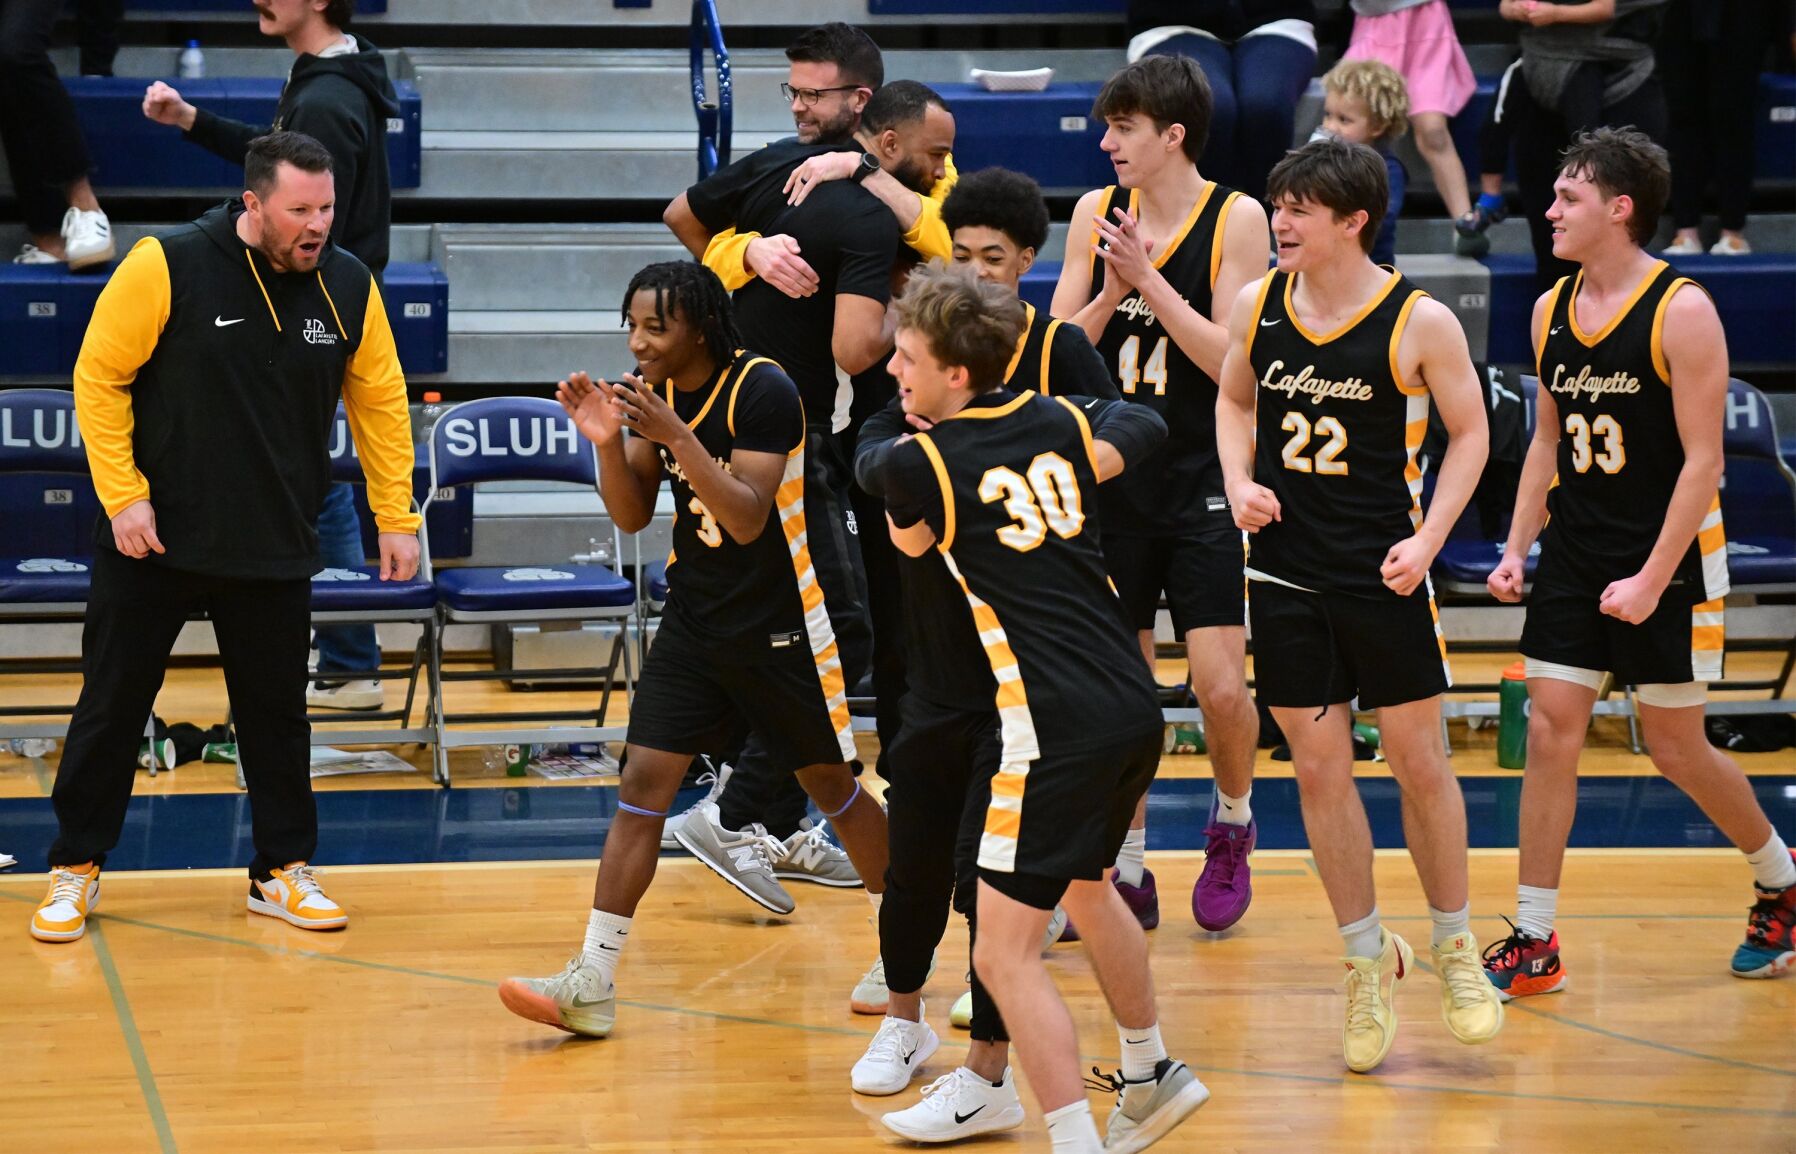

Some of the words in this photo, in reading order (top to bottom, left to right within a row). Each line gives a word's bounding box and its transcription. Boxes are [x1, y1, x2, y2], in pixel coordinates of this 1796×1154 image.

[408, 303, 426, 315] 40
[1118, 334, 1169, 396] 44
[1260, 359, 1374, 405] Lafayette
[1550, 363, 1641, 403] Lafayette
[444, 417, 579, 457] SLUH
[1281, 411, 1349, 476] 22
[1565, 413, 1627, 475] 33
[687, 496, 723, 548] 3
[977, 450, 1086, 553] 30
